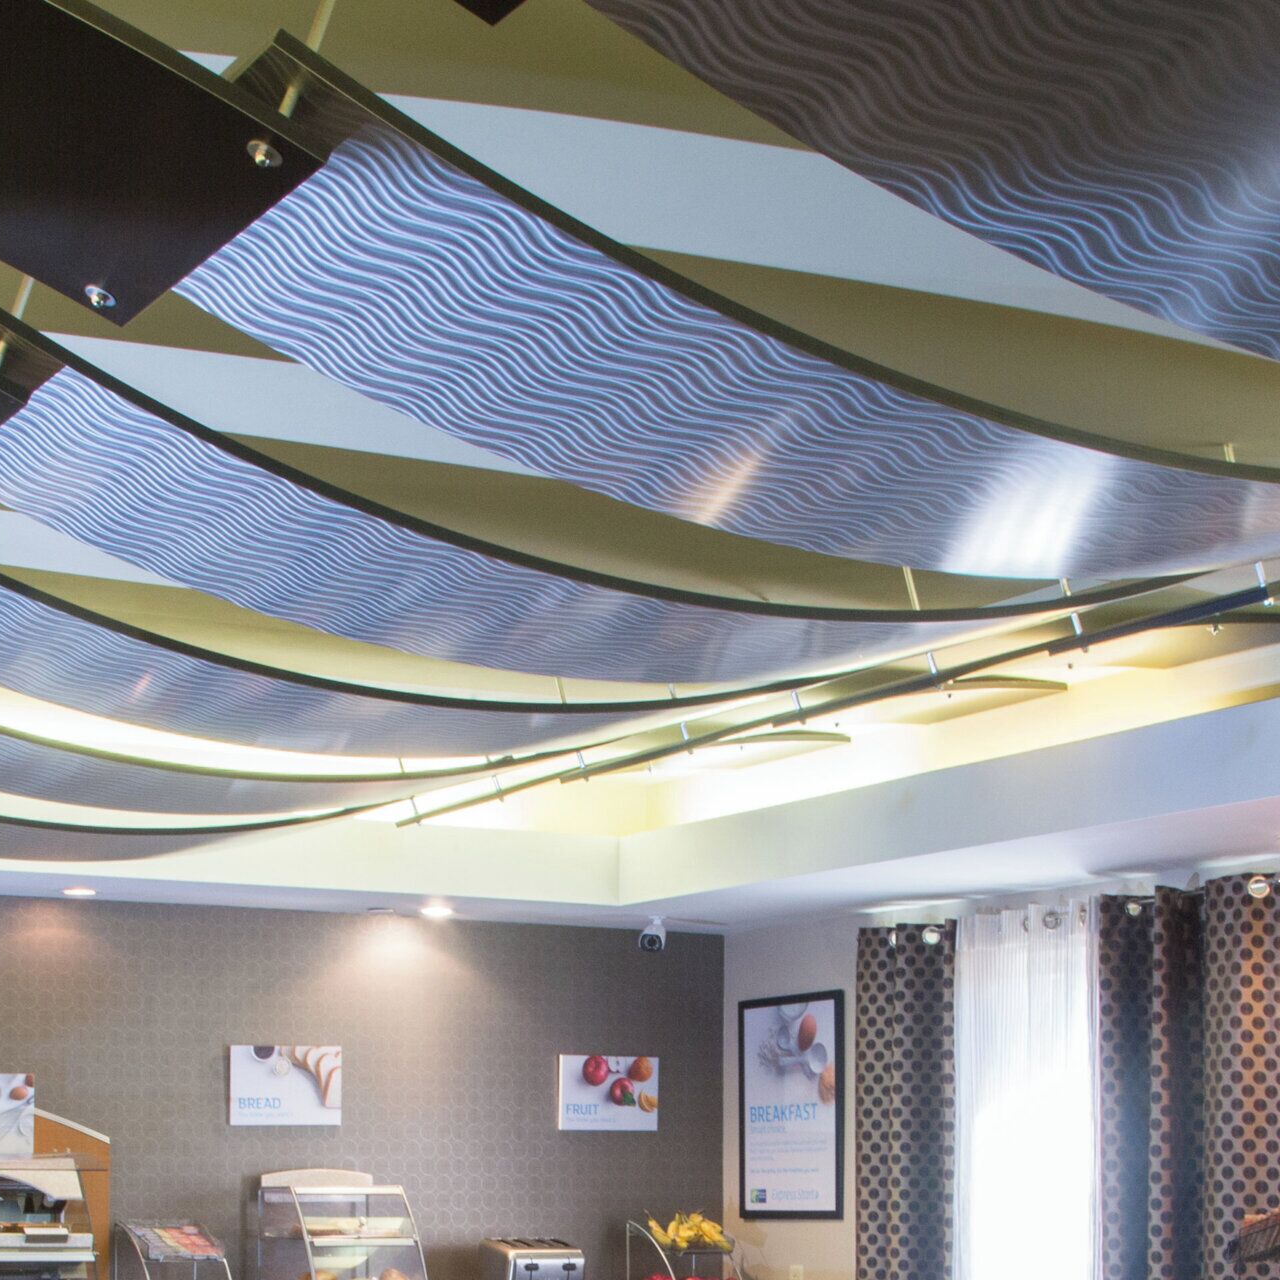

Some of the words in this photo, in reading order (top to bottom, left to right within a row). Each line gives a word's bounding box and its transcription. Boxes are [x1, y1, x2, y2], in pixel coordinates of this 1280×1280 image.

[238, 1097, 281, 1109] BREAD
[566, 1103, 600, 1115] FRUIT
[750, 1103, 818, 1123] BREAKFAST
